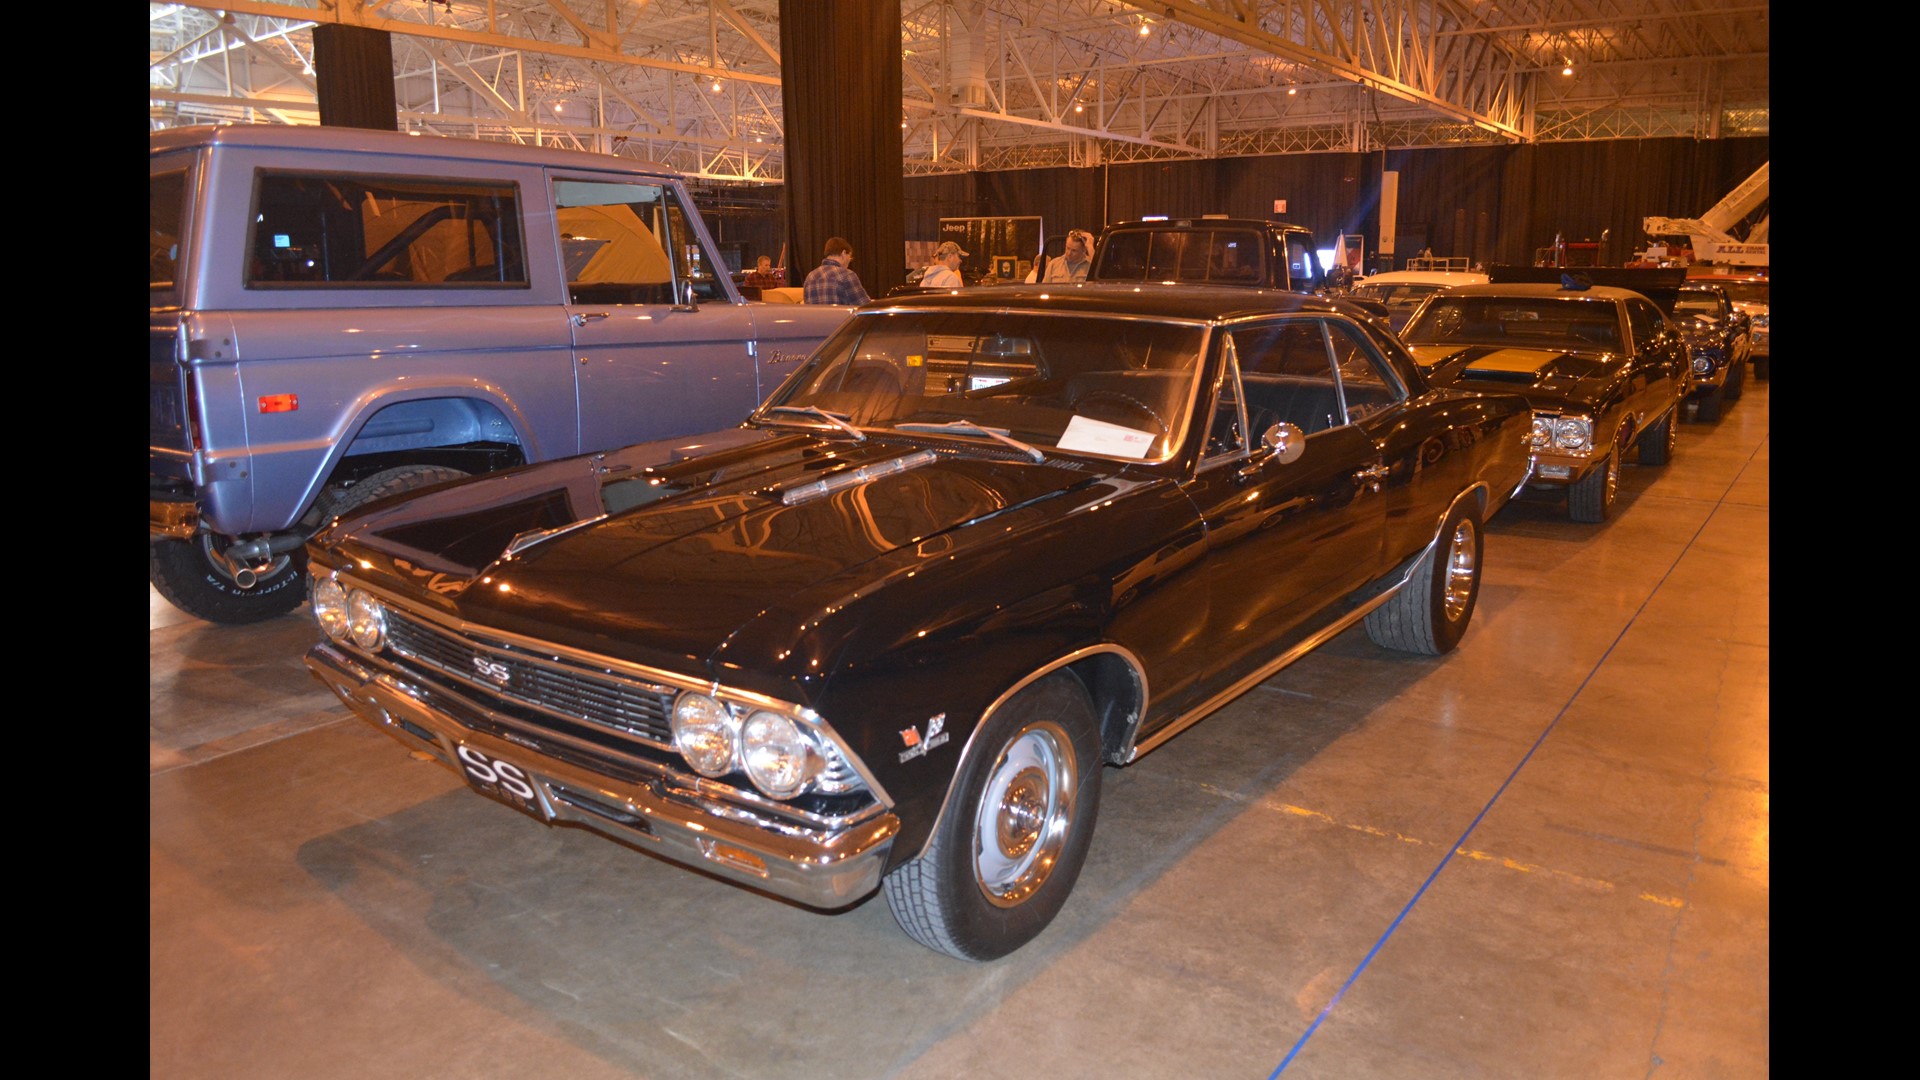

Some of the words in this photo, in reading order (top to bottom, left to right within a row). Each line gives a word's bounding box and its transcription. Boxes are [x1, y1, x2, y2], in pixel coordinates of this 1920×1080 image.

[942, 223, 966, 233] Jeep
[1716, 245, 1744, 254] ALL
[473, 656, 511, 681] SS
[458, 745, 534, 799] SS
